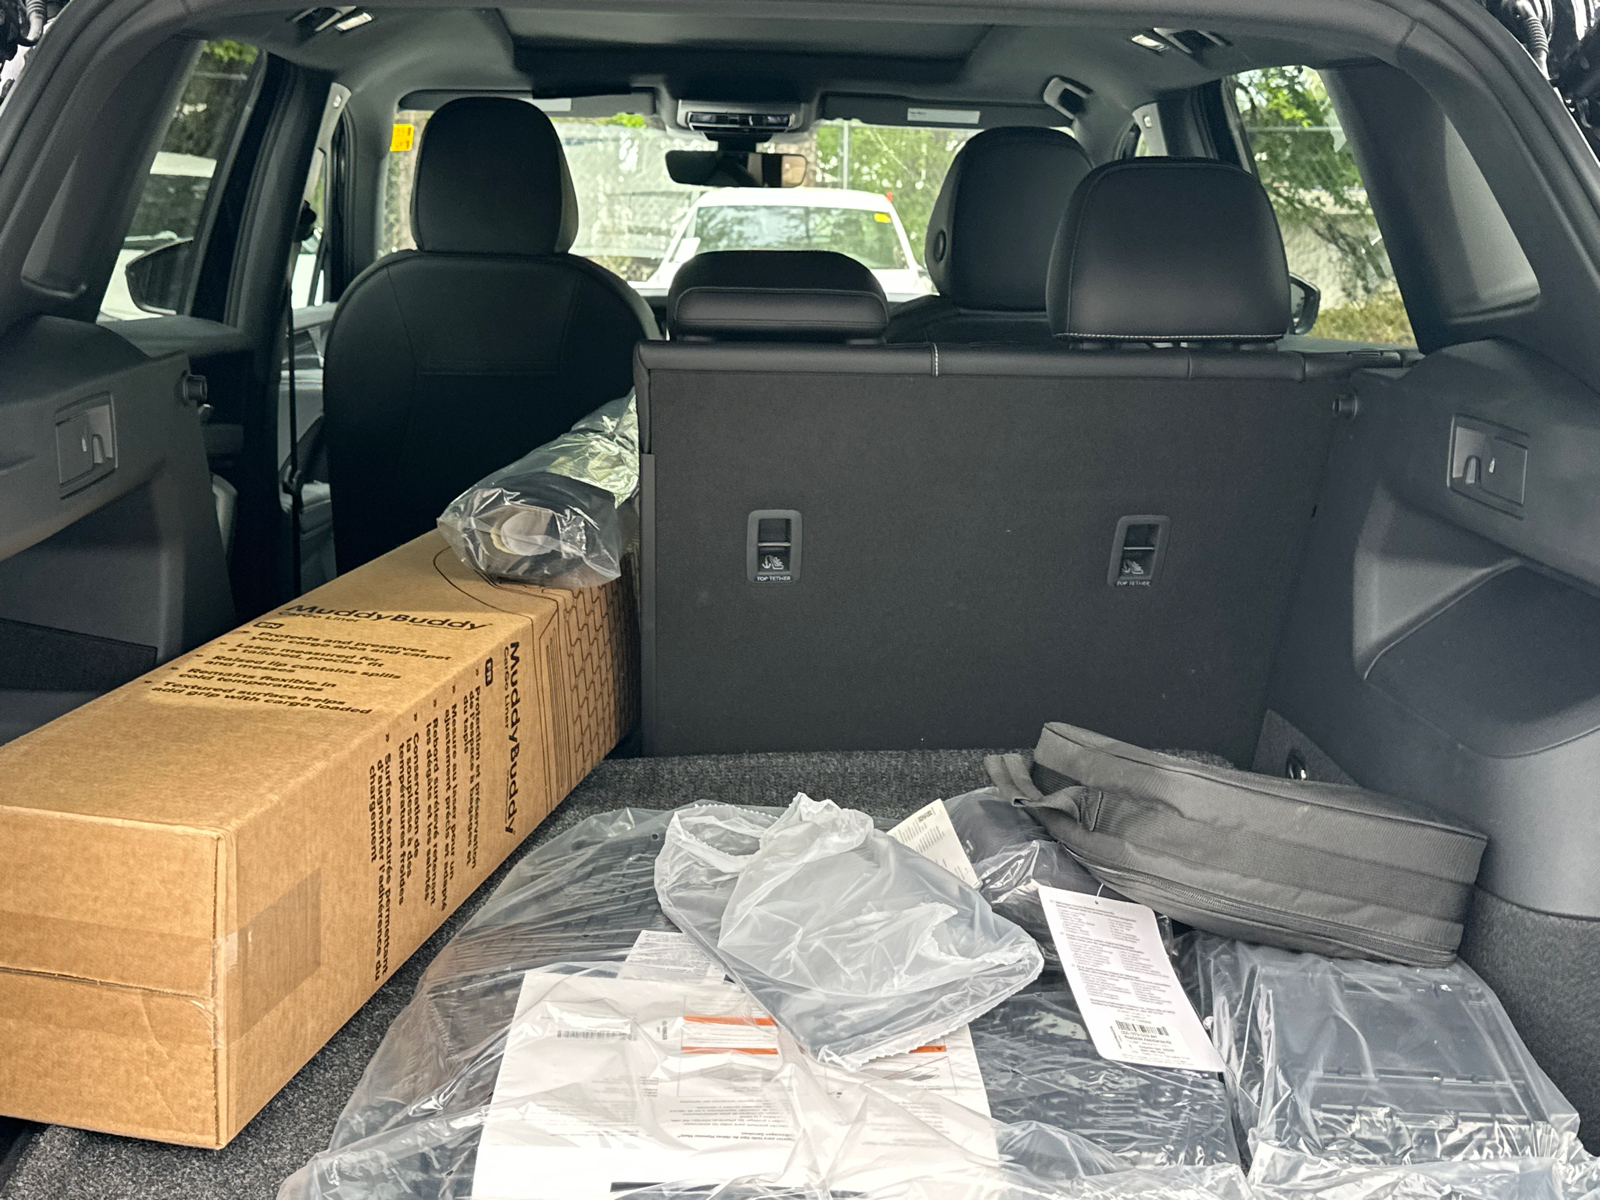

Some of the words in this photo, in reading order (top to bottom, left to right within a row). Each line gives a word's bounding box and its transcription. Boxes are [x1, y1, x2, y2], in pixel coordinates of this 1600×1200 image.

[285, 604, 488, 630] MuddyBuddy
[236, 643, 279, 651] Laser
[280, 648, 357, 659] measured
[258, 632, 320, 641] Protects
[355, 642, 427, 653] preserves
[306, 656, 363, 665] precise
[402, 652, 452, 660] carpet
[187, 668, 256, 679] Remains
[259, 675, 318, 685] flexible
[212, 655, 266, 665] Raised
[291, 664, 357, 674] contains
[360, 671, 401, 679] spills
[236, 664, 296, 673] messes
[163, 681, 236, 693] Textured
[237, 690, 298, 700] surface
[301, 696, 346, 705] helps
[216, 677, 324, 691] temperatures
[314, 703, 373, 714] loaded
[463, 695, 469, 715] du
[469, 691, 474, 709] de
[406, 737, 412, 753] la
[505, 641, 520, 834] MuddyBuddy
[452, 763, 457, 782] au
[475, 764, 481, 779] et
[399, 742, 407, 849] températures
[369, 765, 377, 863] chargement
[427, 804, 432, 821] et
[414, 839, 420, 858] de
[444, 842, 450, 858] et
[466, 850, 472, 866] et
[430, 842, 438, 907] retenant
[449, 860, 455, 881] un
[441, 861, 449, 911] adapté
[382, 888, 391, 975] permettant
[375, 960, 381, 982] du
